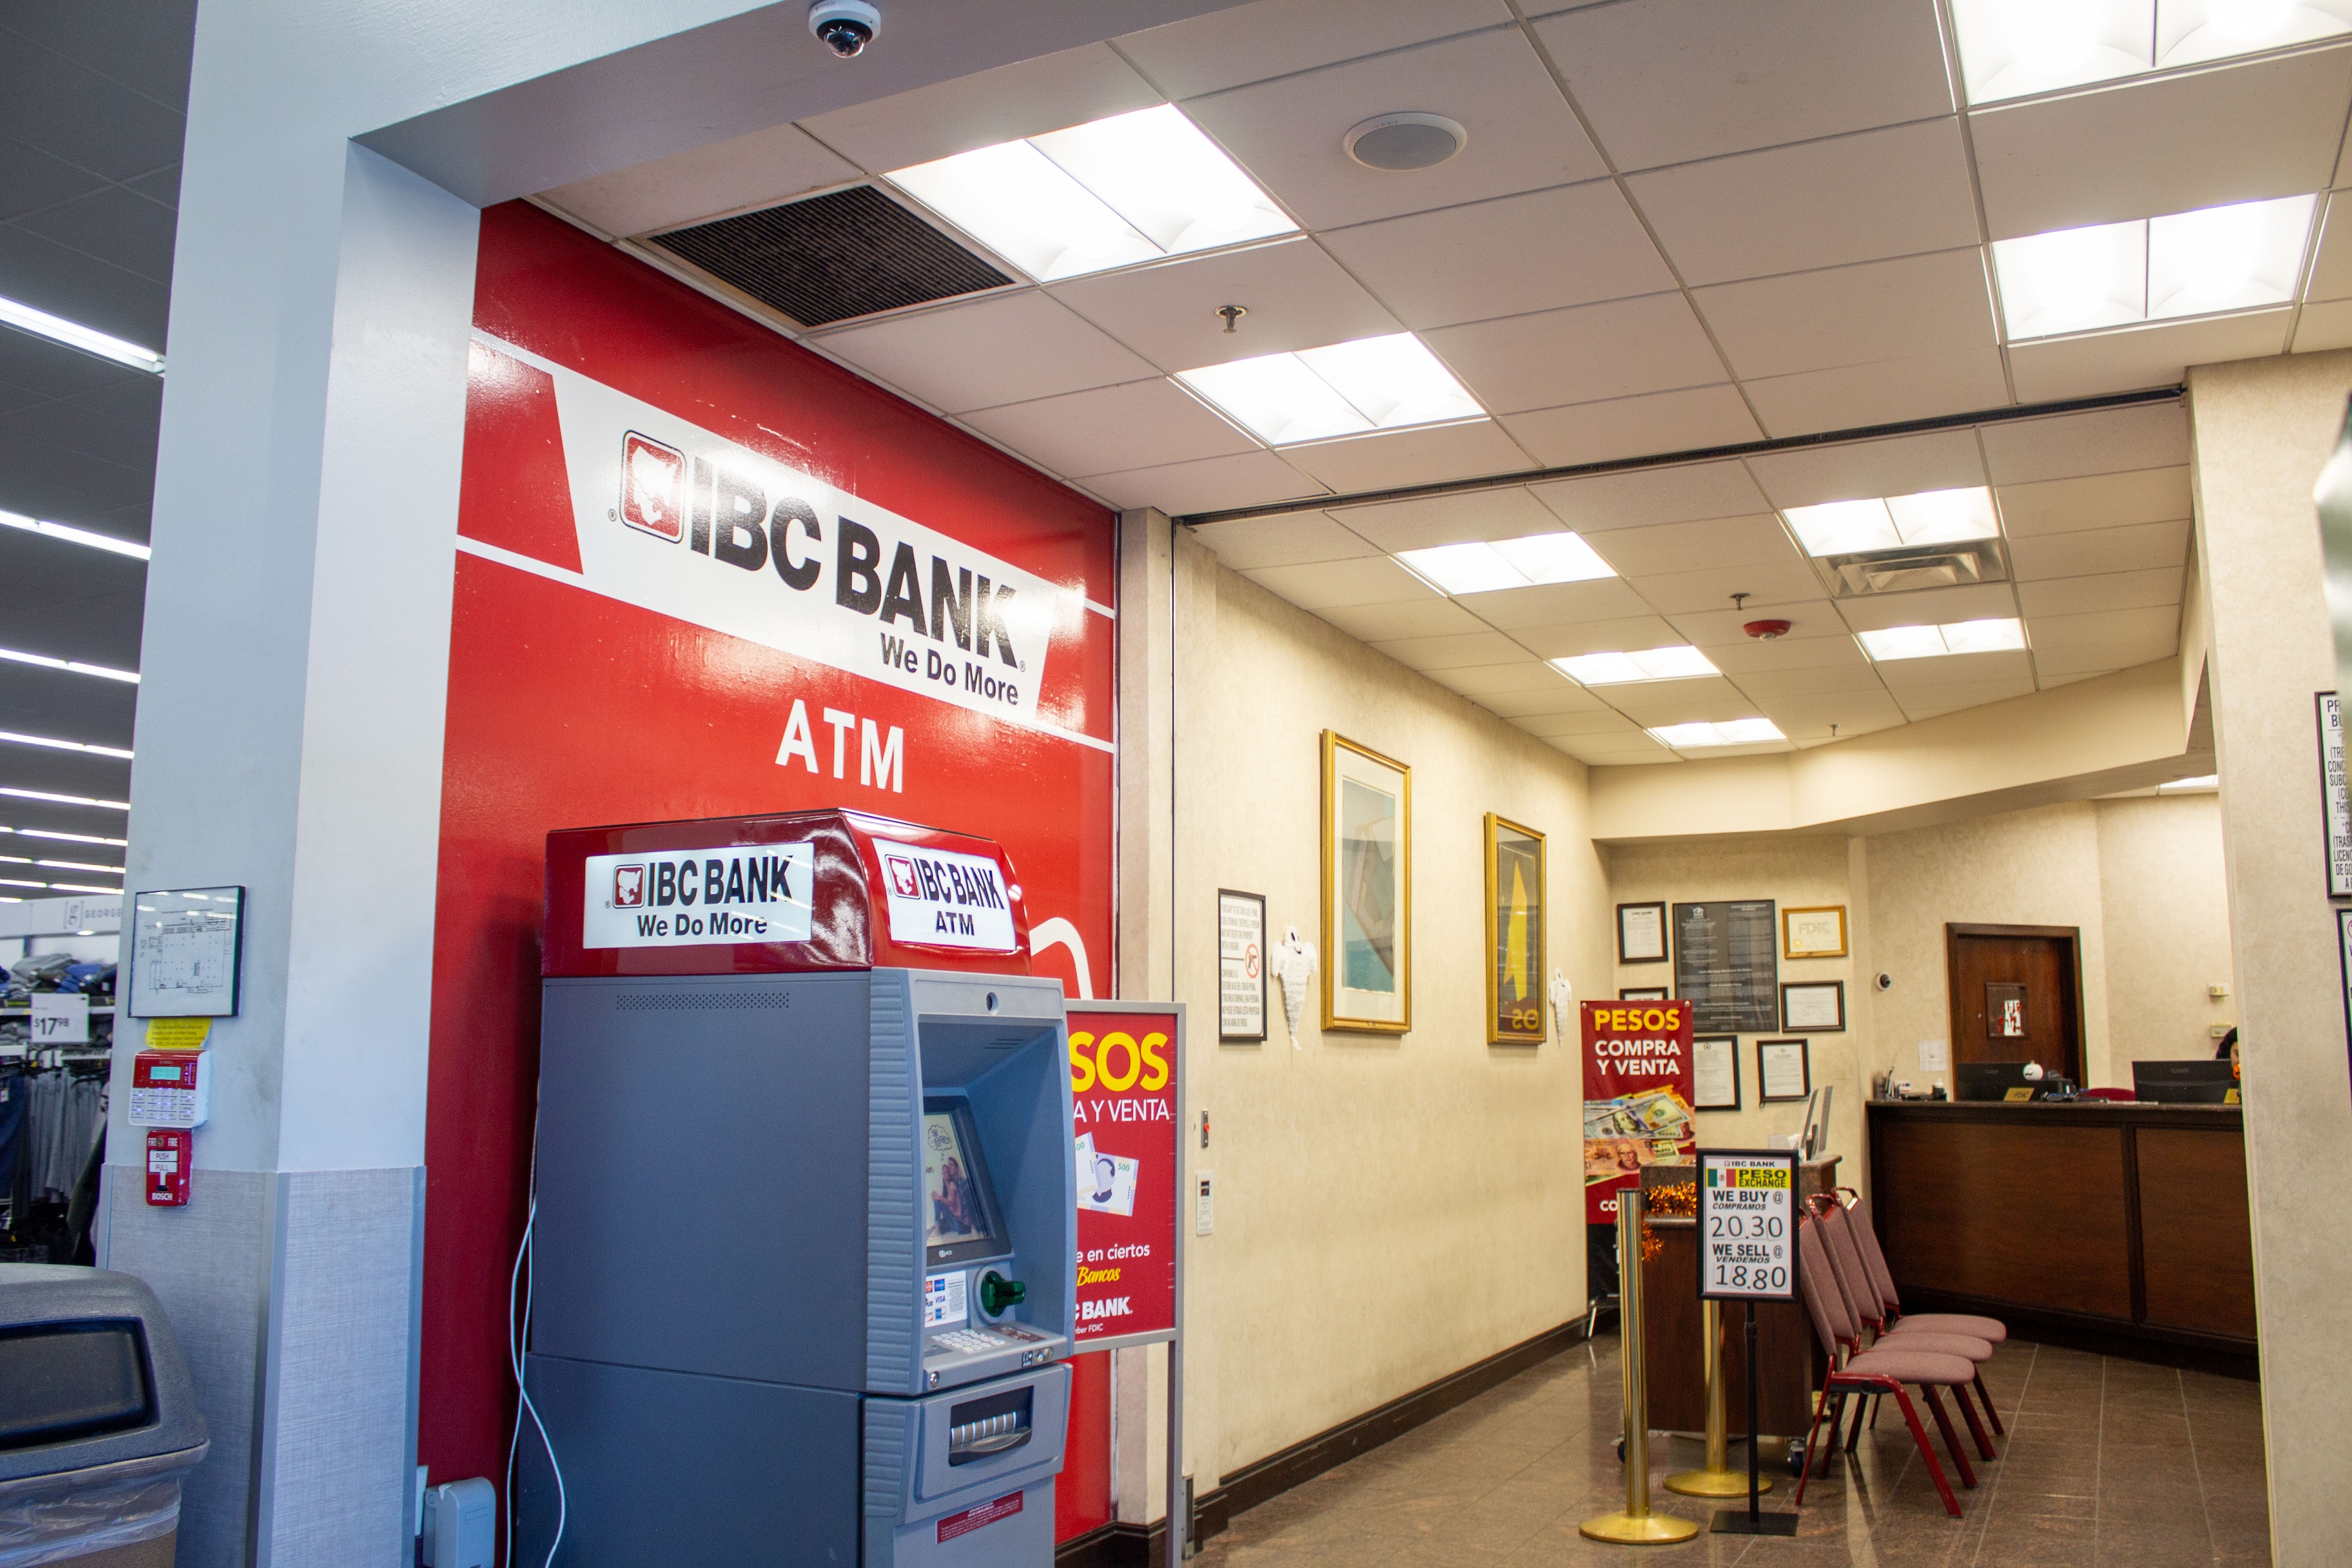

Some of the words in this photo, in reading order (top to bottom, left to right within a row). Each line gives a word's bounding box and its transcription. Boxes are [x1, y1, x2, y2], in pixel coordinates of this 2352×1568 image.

[690, 456, 821, 590] IBC
[835, 515, 1017, 669] BANK
[880, 632, 918, 673] We
[927, 648, 956, 686] Do
[965, 662, 1018, 706] More
[775, 698, 903, 793] ATM
[648, 859, 698, 907] IBC
[704, 855, 793, 905] BANK
[913, 858, 951, 903] IBC
[946, 863, 1005, 910] BANK
[637, 914, 668, 937] We
[675, 914, 703, 936] Do
[709, 913, 767, 935] More
[935, 911, 974, 936] ATM
[1594, 1008, 1680, 1031] PESOS
[1595, 1039, 1681, 1057] COMPRA
[1596, 1059, 1610, 1075] Y
[1614, 1059, 1680, 1076] VENTA
[1090, 1100, 1104, 1123] Y
[1107, 1099, 1170, 1122] VENTA
[168, 1137, 178, 1147] FIRE
[1118, 1163, 1130, 1172] 500
[1739, 1169, 1787, 1178] PESO
[1739, 1178, 1785, 1188] EXCHANGE
[1713, 1191, 1734, 1202] WE
[1740, 1191, 1769, 1202] BUY
[1773, 1191, 1783, 1204] @
[1710, 1216, 1783, 1239] 20.30
[1087, 1249, 1103, 1262] en
[1107, 1243, 1150, 1260] ciertos
[1713, 1243, 1733, 1255] WE
[1737, 1244, 1770, 1256] SELL
[1773, 1245, 1783, 1259] @
[1077, 1266, 1121, 1286] Bancos
[1716, 1264, 1786, 1291] 18.80
[1088, 1323, 1103, 1333] FDIC
